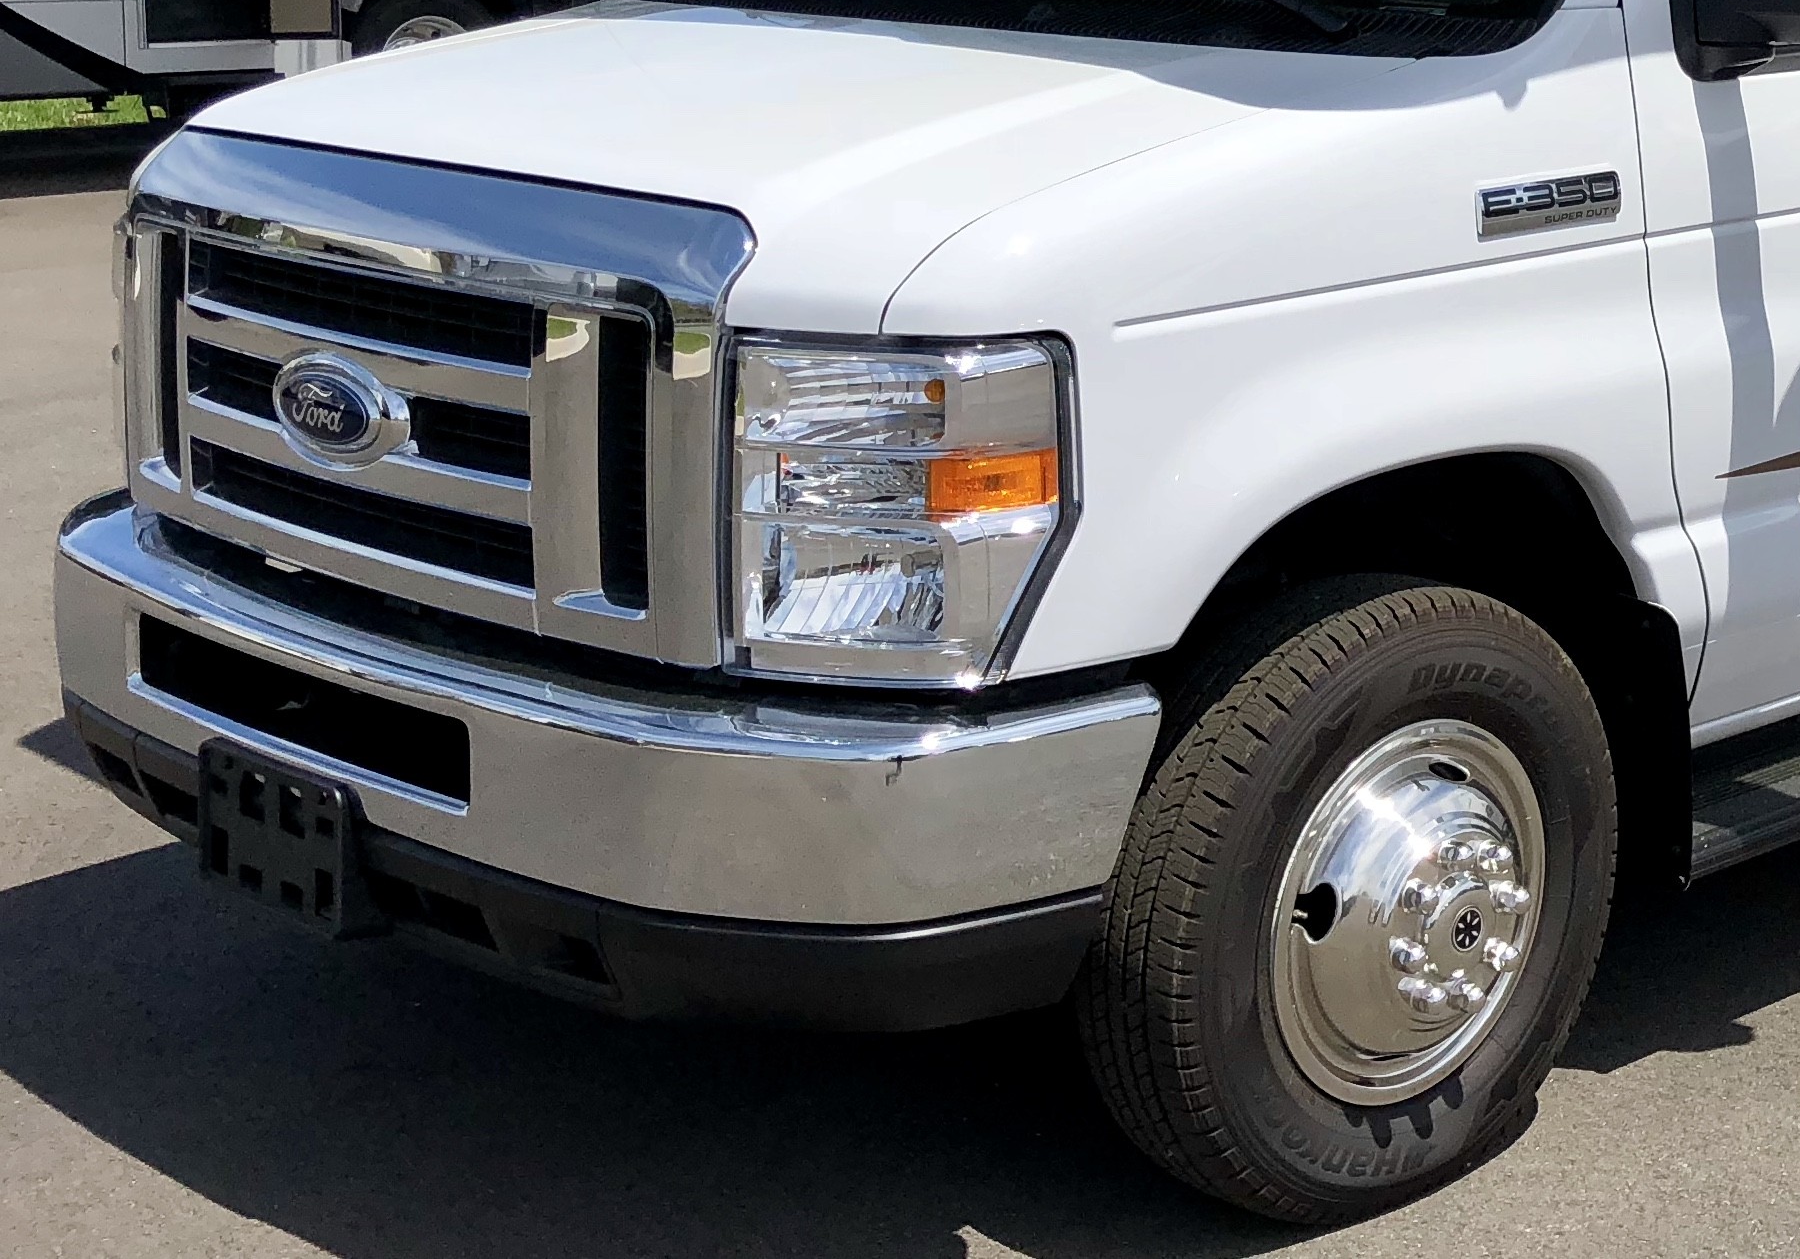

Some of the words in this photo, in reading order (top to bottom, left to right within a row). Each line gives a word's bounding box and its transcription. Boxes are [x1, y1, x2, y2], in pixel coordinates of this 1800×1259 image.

[1481, 174, 1621, 219] E-350
[1544, 210, 1584, 225] SUPER
[1585, 206, 1618, 219] DUTY
[291, 381, 346, 433] Ford
